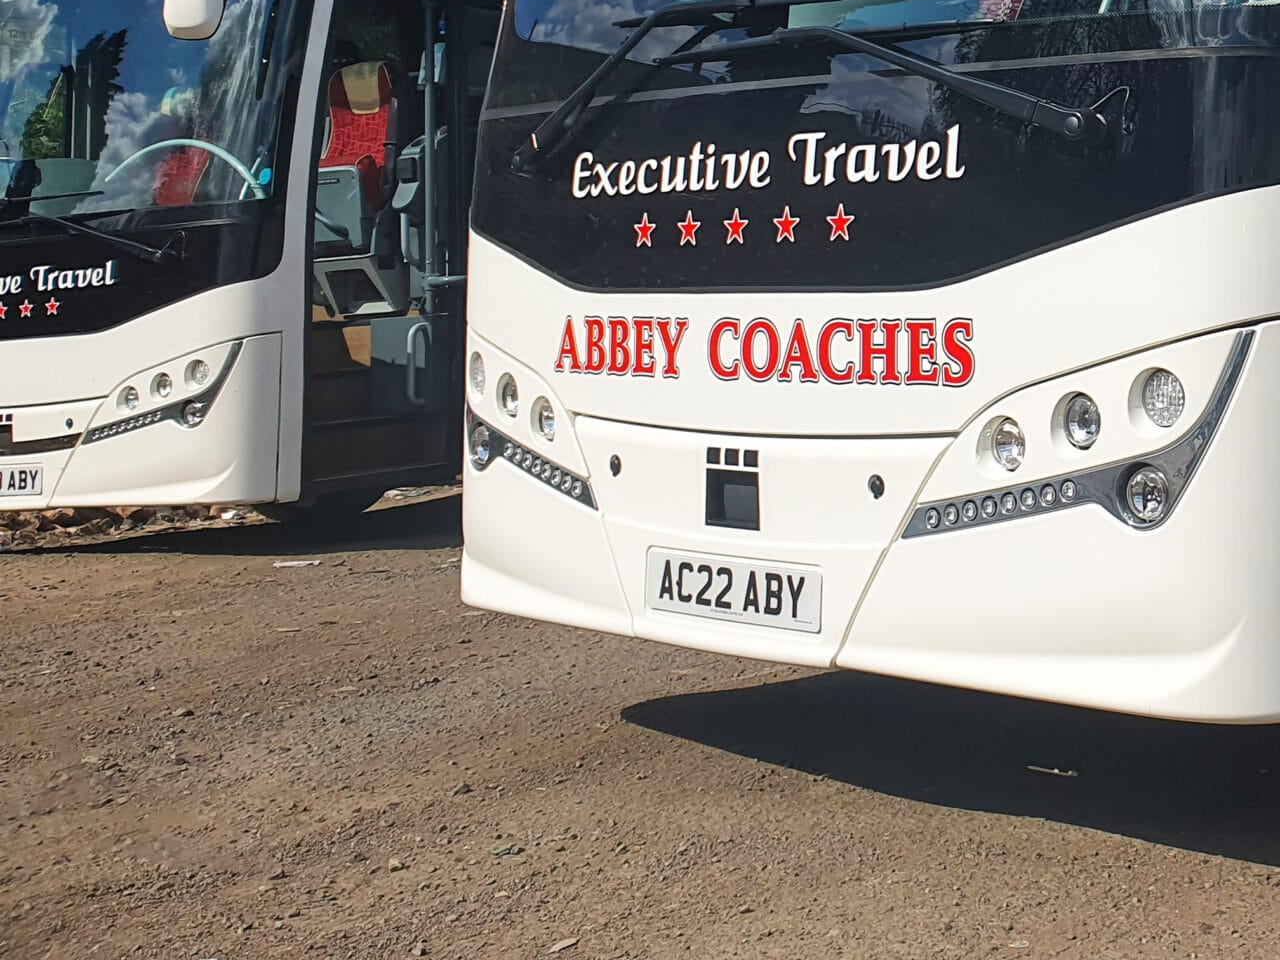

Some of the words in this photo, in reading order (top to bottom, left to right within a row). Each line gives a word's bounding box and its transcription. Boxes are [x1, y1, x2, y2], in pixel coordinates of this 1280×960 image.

[571, 141, 771, 198] Executive
[787, 124, 966, 186] Travel
[30, 260, 115, 291] Travel
[554, 315, 689, 378] ABBEY
[707, 316, 976, 387] COACHES
[7, 470, 38, 490] ABY
[659, 559, 733, 609] AC22
[743, 570, 805, 618] ABY
